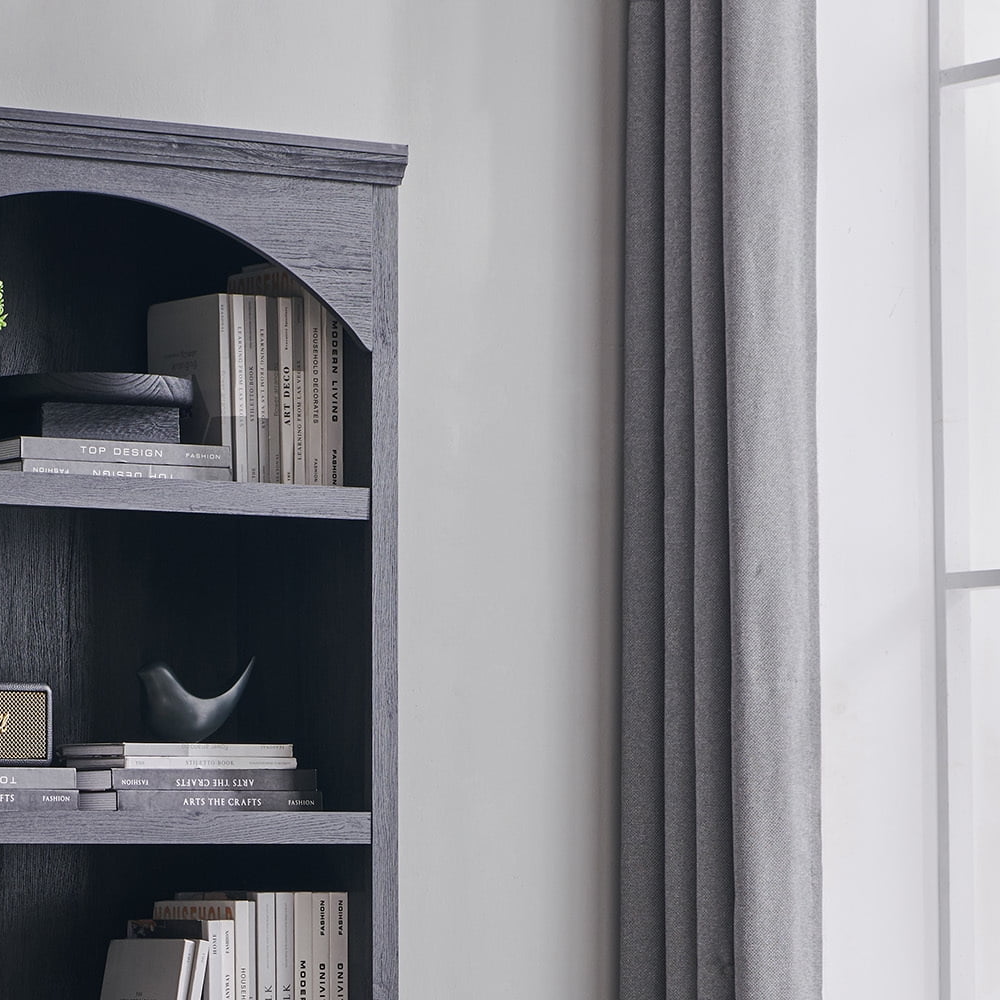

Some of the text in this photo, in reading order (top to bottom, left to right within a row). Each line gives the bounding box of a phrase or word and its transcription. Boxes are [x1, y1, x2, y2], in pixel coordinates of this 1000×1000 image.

[283, 403, 291, 426] ART
[80, 445, 106, 455] TOP
[113, 447, 163, 458] DESIGN
[32, 466, 69, 474] FASHION
[176, 779, 211, 788] CRAFTS
[212, 779, 230, 787] THE
[232, 778, 254, 787] ARTS
[183, 798, 206, 806] ARTS
[208, 798, 226, 806] THE
[228, 798, 262, 806] CRAFTS
